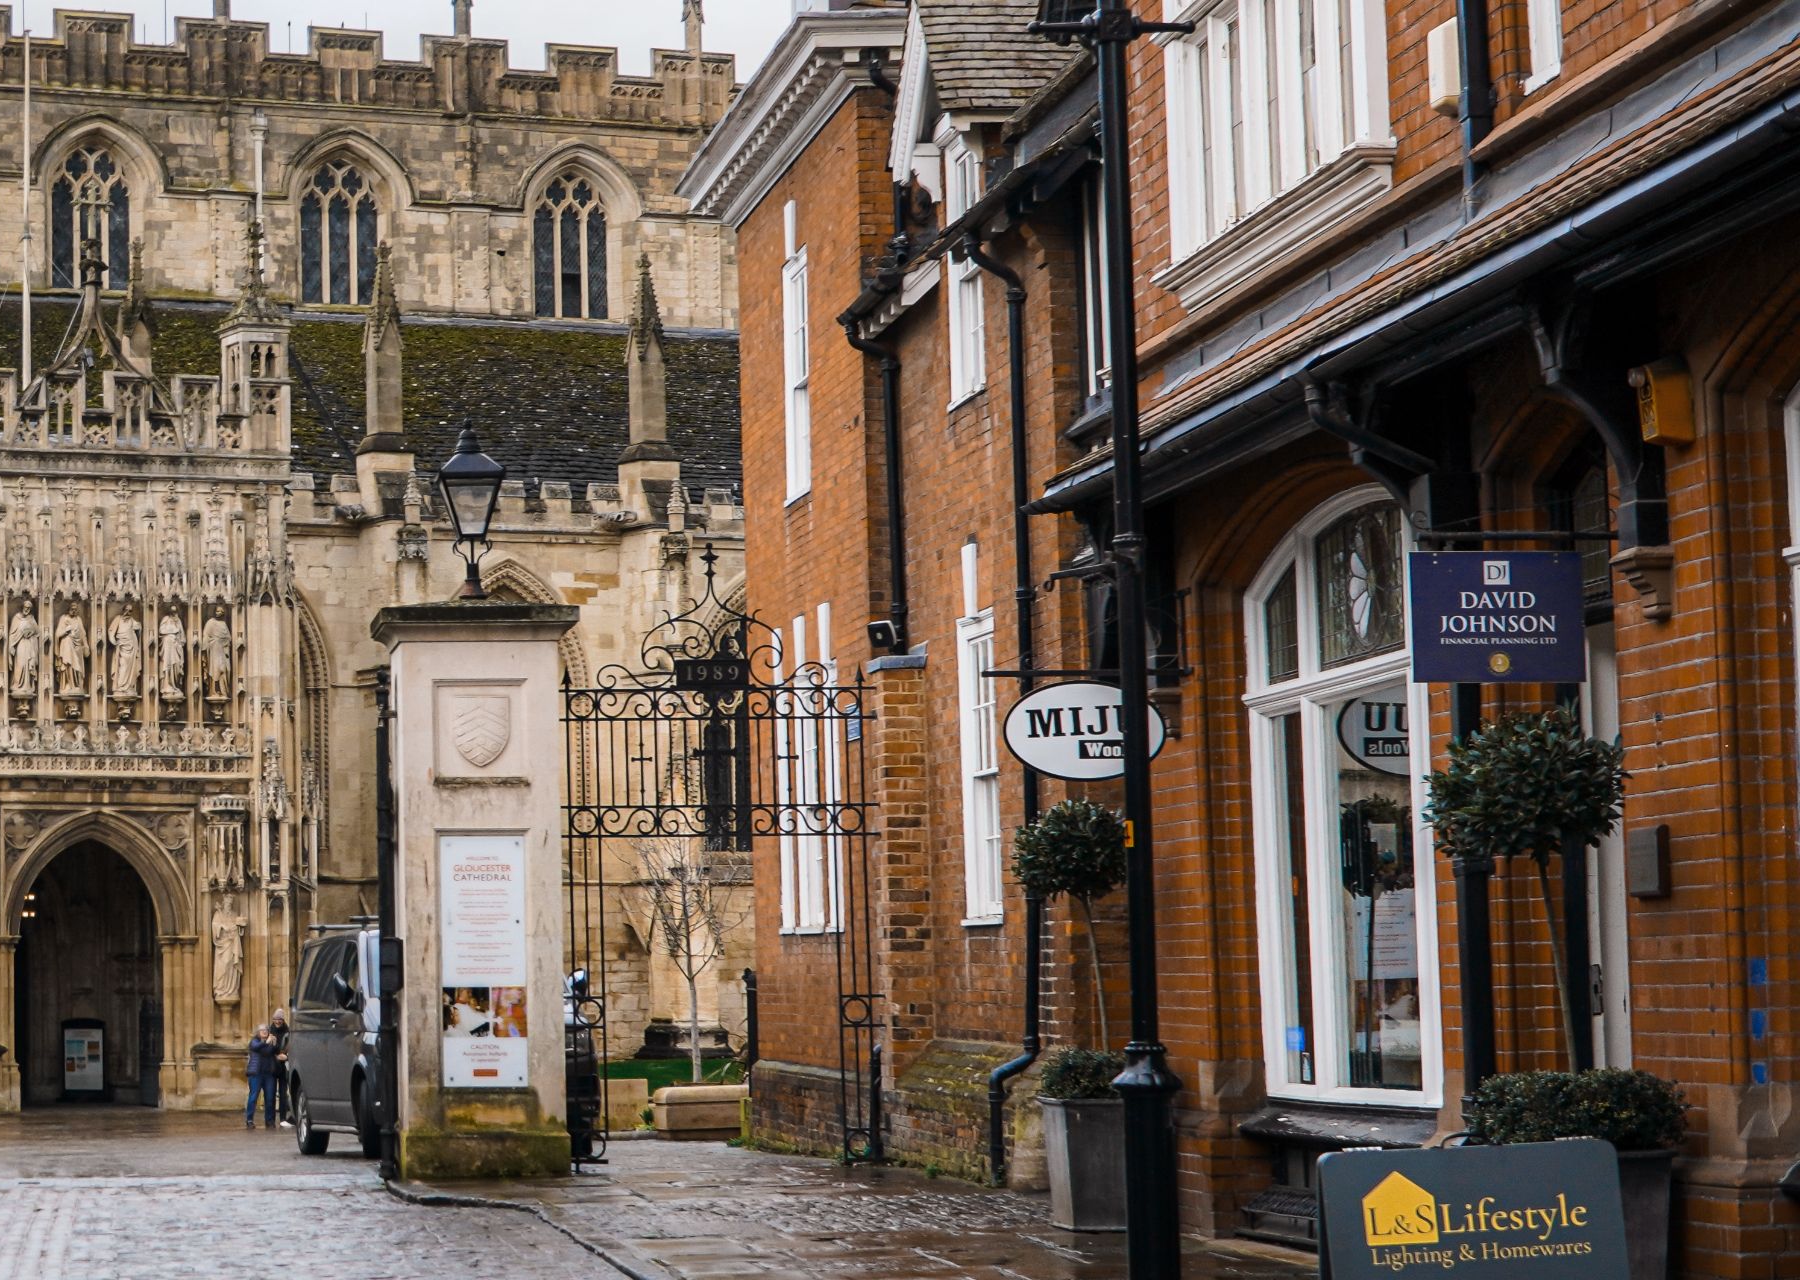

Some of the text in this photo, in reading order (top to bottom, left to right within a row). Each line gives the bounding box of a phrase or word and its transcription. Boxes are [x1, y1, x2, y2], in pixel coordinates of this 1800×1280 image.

[1486, 564, 1508, 580] DJ
[1459, 591, 1536, 609] DAVID
[1439, 614, 1557, 634] JOHNSON
[1440, 637, 1558, 645] FINANCIAL PLANNING LTD
[685, 665, 740, 681] 1989
[1084, 742, 1125, 758] Woo
[453, 864, 512, 872] GLOUCESTER
[453, 873, 513, 882] CATHEDRAL
[1368, 1192, 1588, 1241] L&S Lifestyle
[1371, 1240, 1593, 1271] Lighting & Homewares
